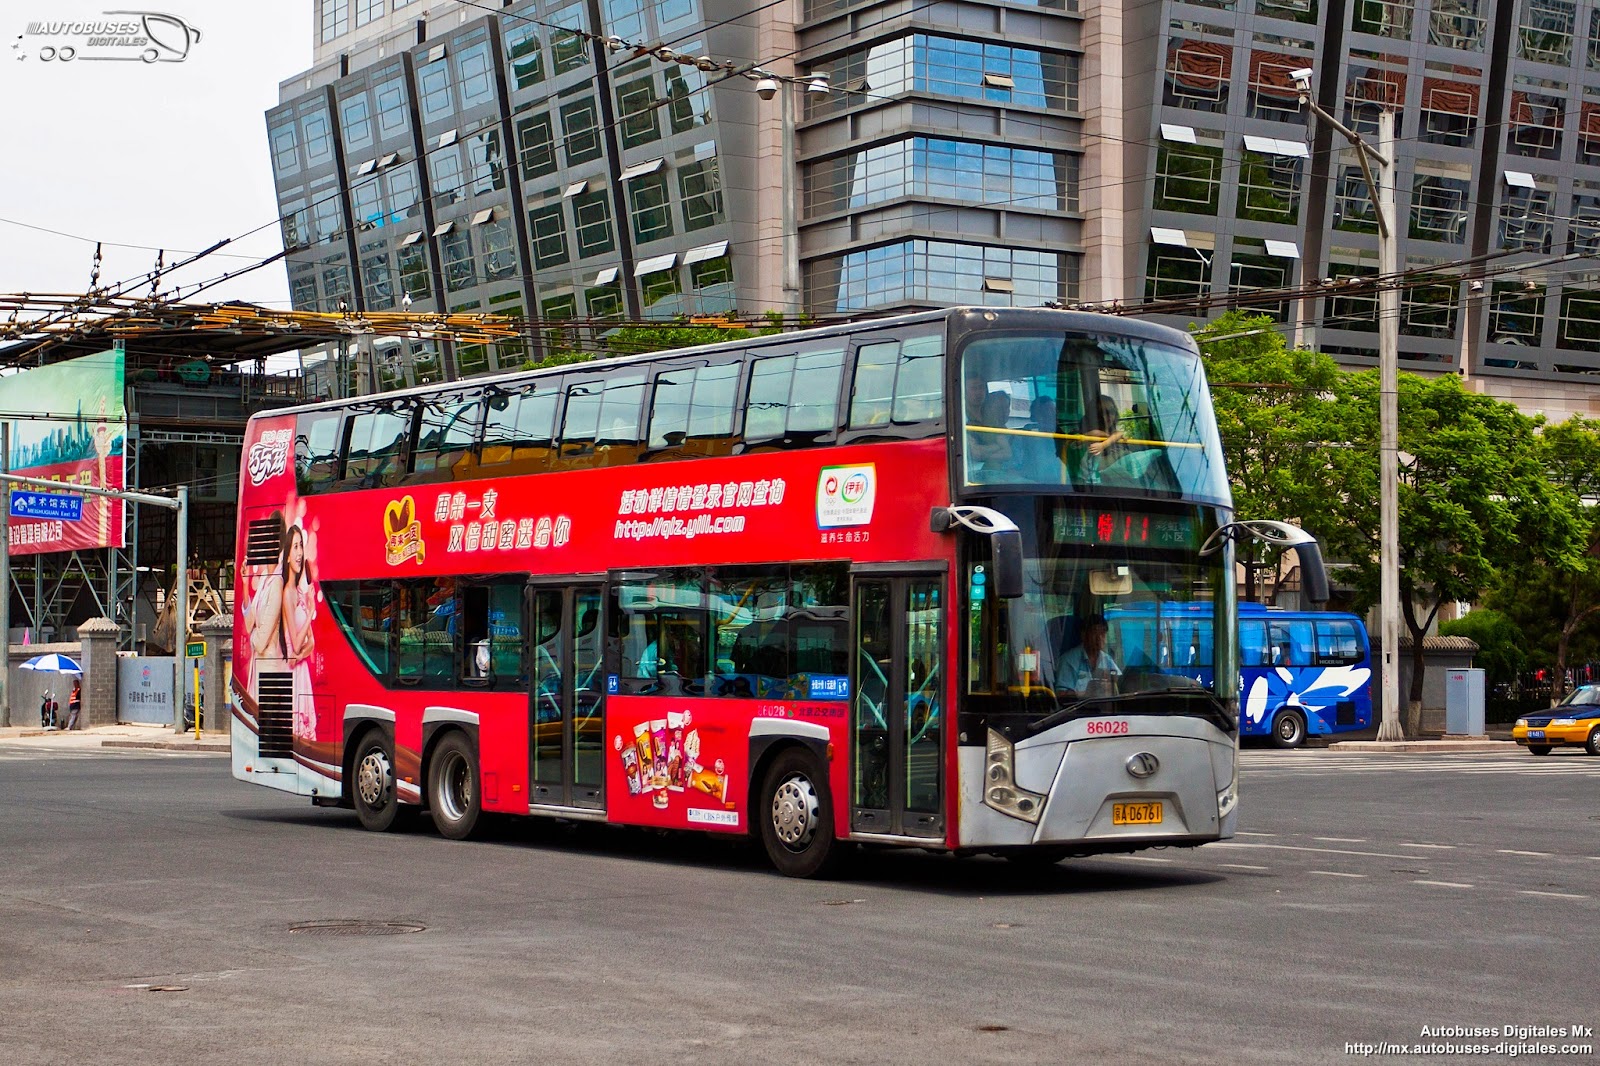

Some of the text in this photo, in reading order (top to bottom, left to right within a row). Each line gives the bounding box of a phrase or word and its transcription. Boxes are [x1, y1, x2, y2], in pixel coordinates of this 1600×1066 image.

[845, 481, 864, 495] 伊利
[28, 495, 79, 510] 美术馆东街
[618, 478, 786, 515] 活动详情请登录官网查询
[434, 489, 498, 522] 再来一支
[447, 515, 570, 552] 双倍甜蜜送给你
[820, 531, 870, 544] 滋养生命活力
[1161, 532, 1185, 542] 小区
[1087, 721, 1129, 734] 86028
